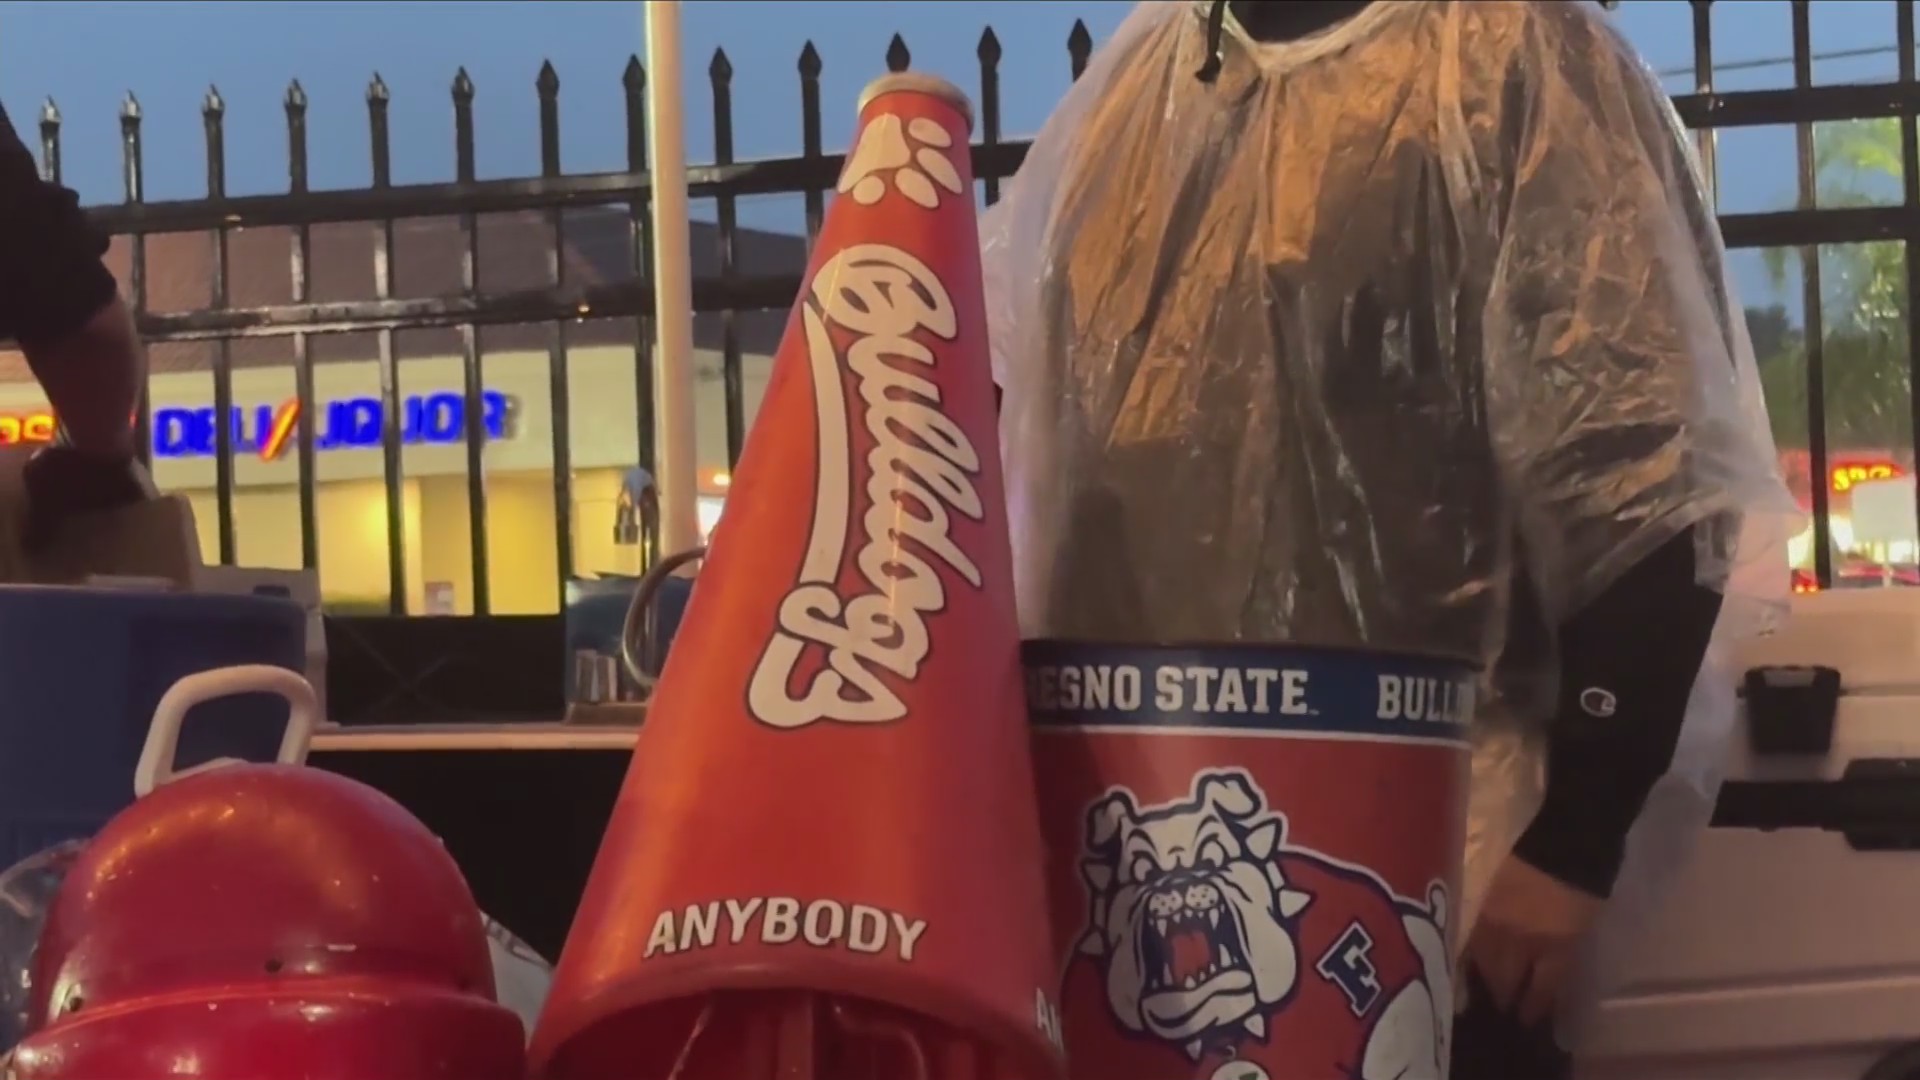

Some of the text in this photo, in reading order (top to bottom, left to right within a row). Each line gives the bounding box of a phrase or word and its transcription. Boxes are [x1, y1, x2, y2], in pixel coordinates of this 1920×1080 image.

[747, 242, 984, 727] Bulldogs
[1154, 666, 1309, 716] STATE
[642, 896, 928, 961] ANYBODY
[1316, 921, 1381, 1018] F
